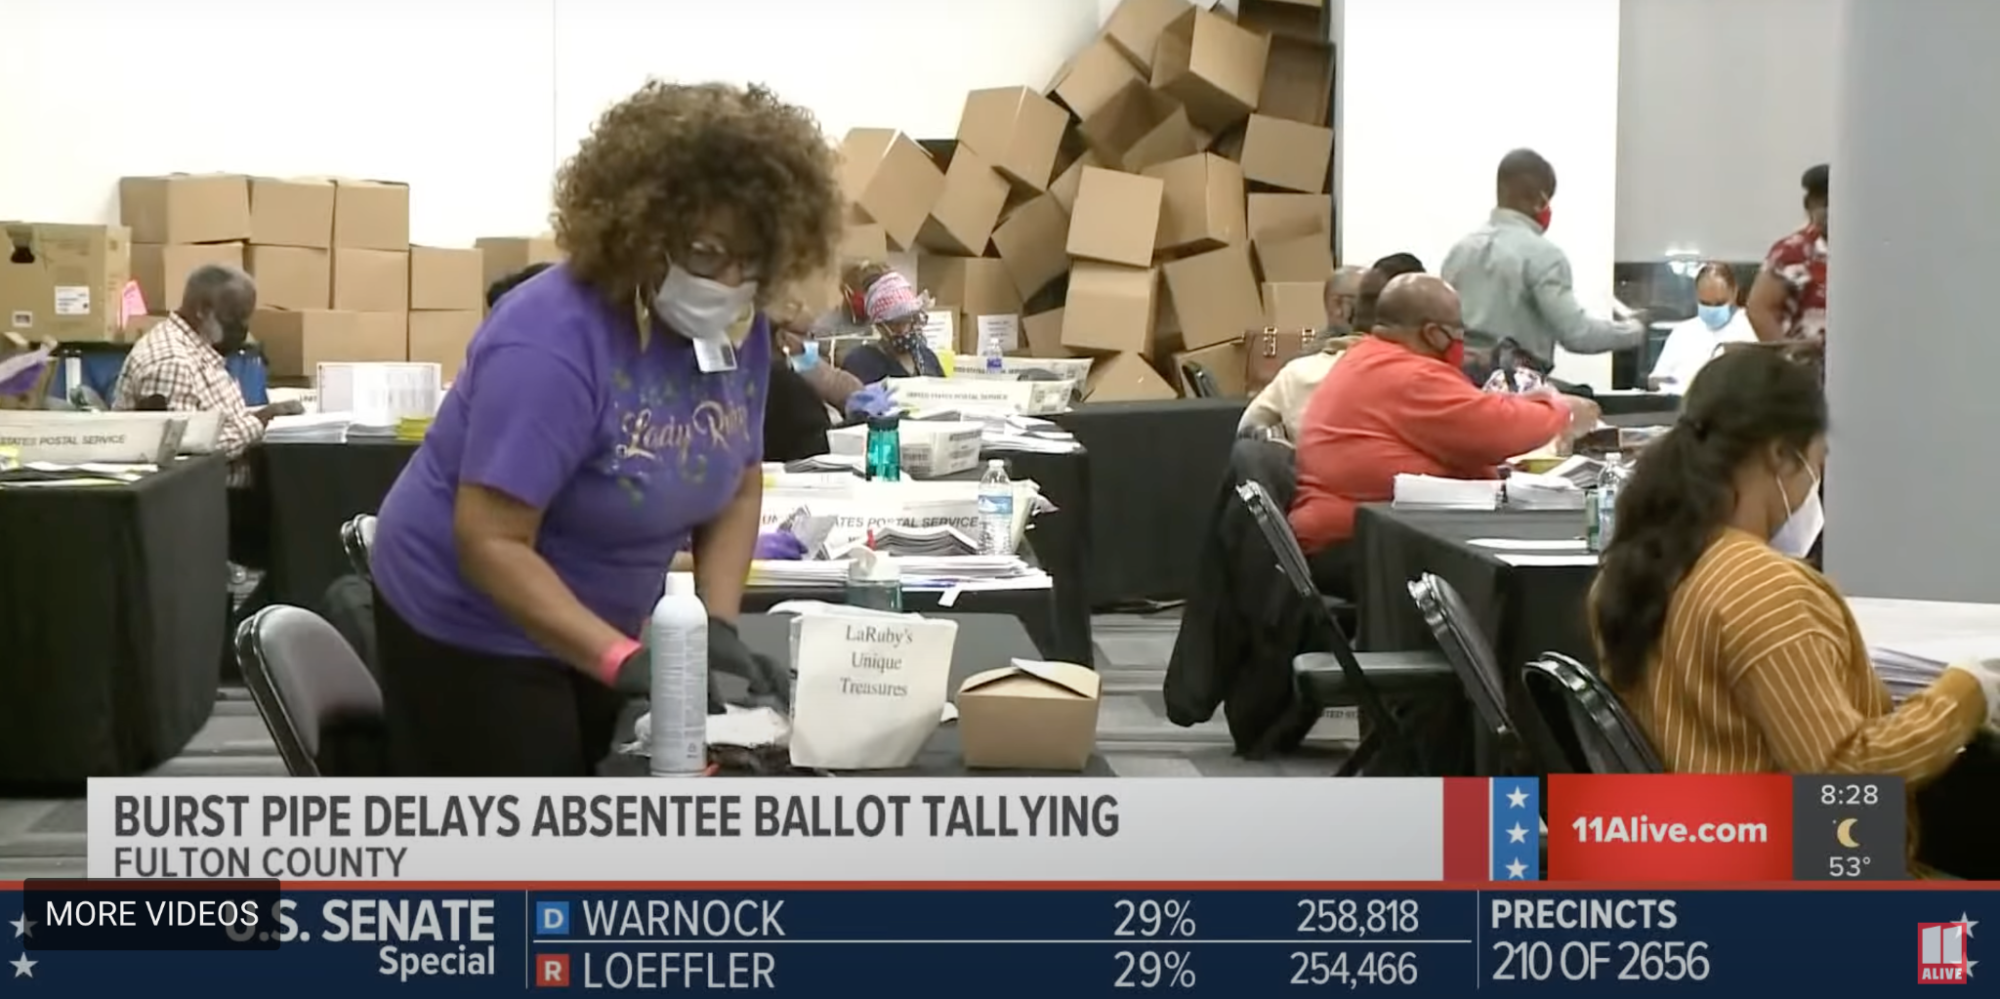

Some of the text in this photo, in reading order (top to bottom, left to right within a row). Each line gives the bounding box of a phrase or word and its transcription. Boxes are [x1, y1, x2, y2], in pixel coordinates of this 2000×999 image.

[39, 435, 78, 446] POSTAL
[82, 433, 126, 445] SERVICE
[615, 408, 693, 464] Lady
[833, 516, 865, 528] ATES
[845, 624, 914, 648] LaRuby's
[851, 651, 903, 674] Unique
[839, 677, 909, 697] Treasures
